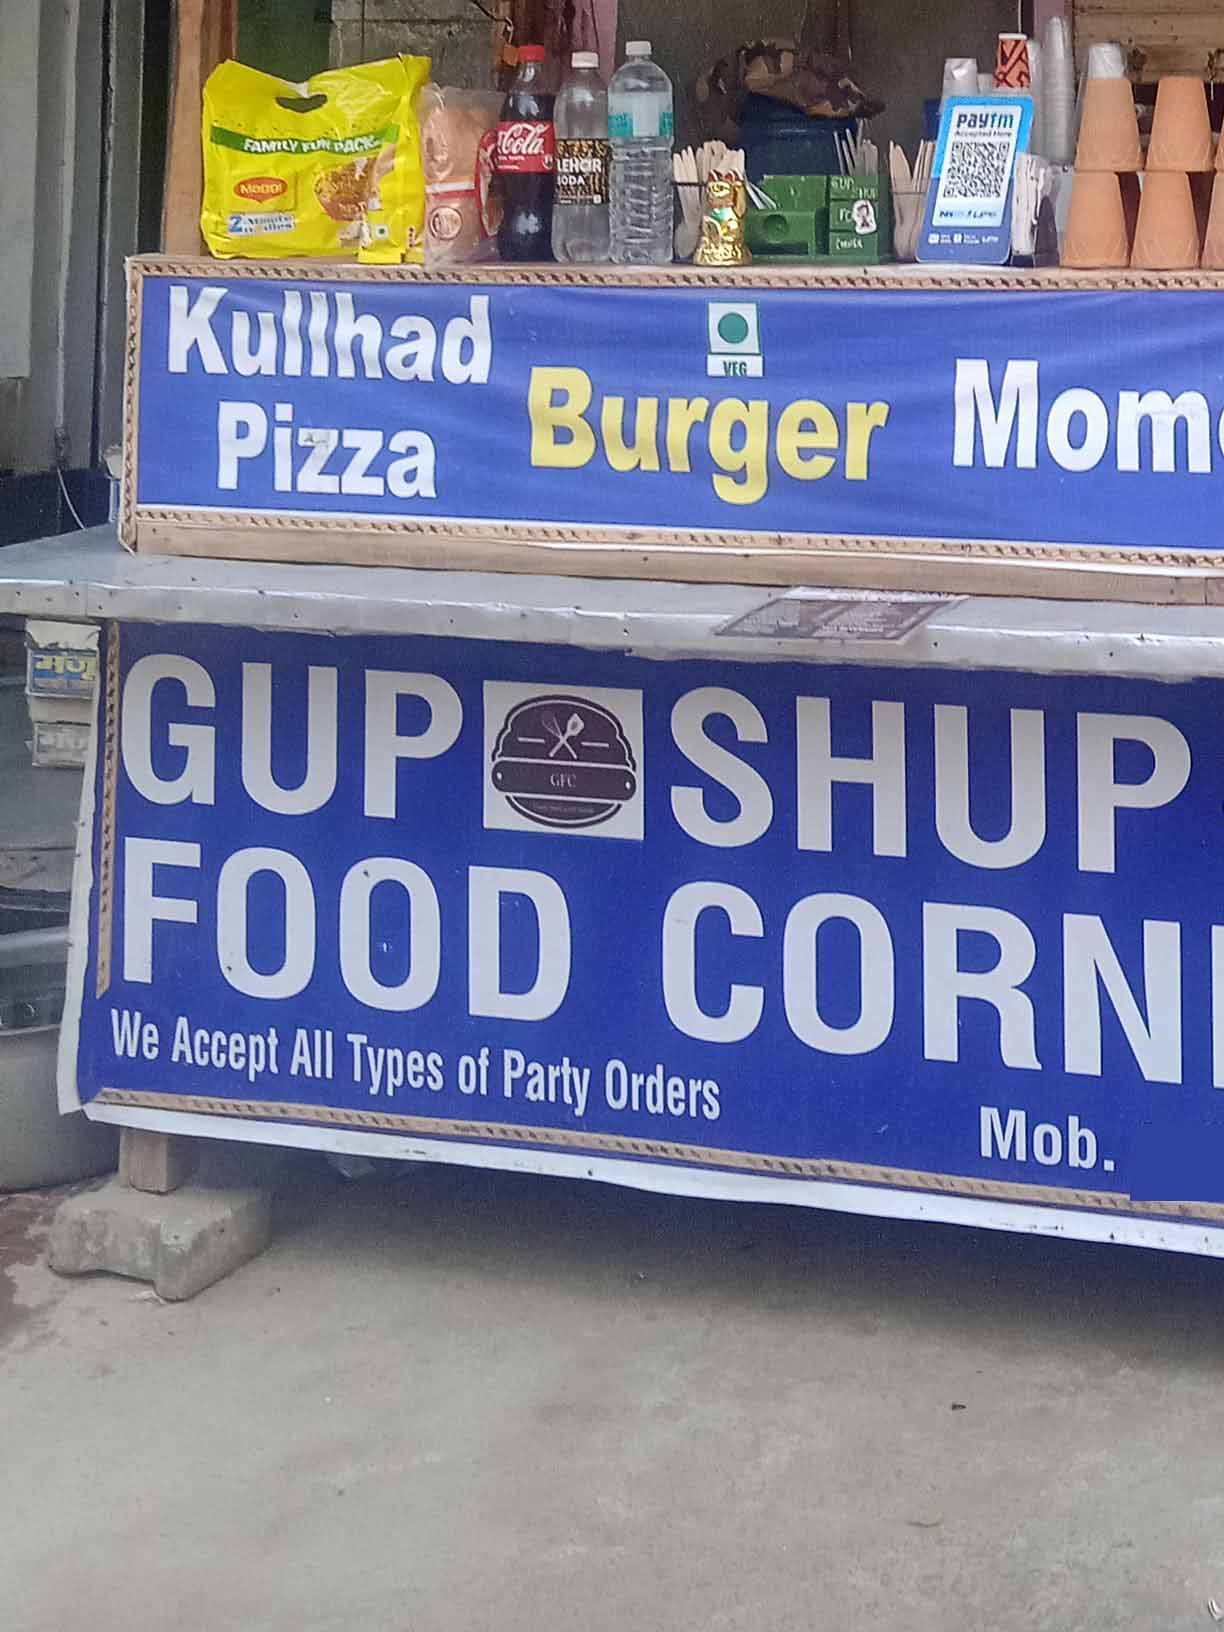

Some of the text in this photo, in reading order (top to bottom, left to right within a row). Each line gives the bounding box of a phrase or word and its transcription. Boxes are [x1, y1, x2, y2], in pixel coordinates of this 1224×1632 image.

[243, 137, 298, 153] FAMILY
[166, 284, 494, 385] Kullhad
[215, 400, 437, 499] Pizza
[528, 365, 890, 506] Burger
[121, 653, 1191, 873] GUP SHUP
[123, 836, 572, 1022] FOOD
[111, 1009, 721, 1120] We Accept All Types of Party Orders
[981, 1106, 1116, 1173] Mob.
